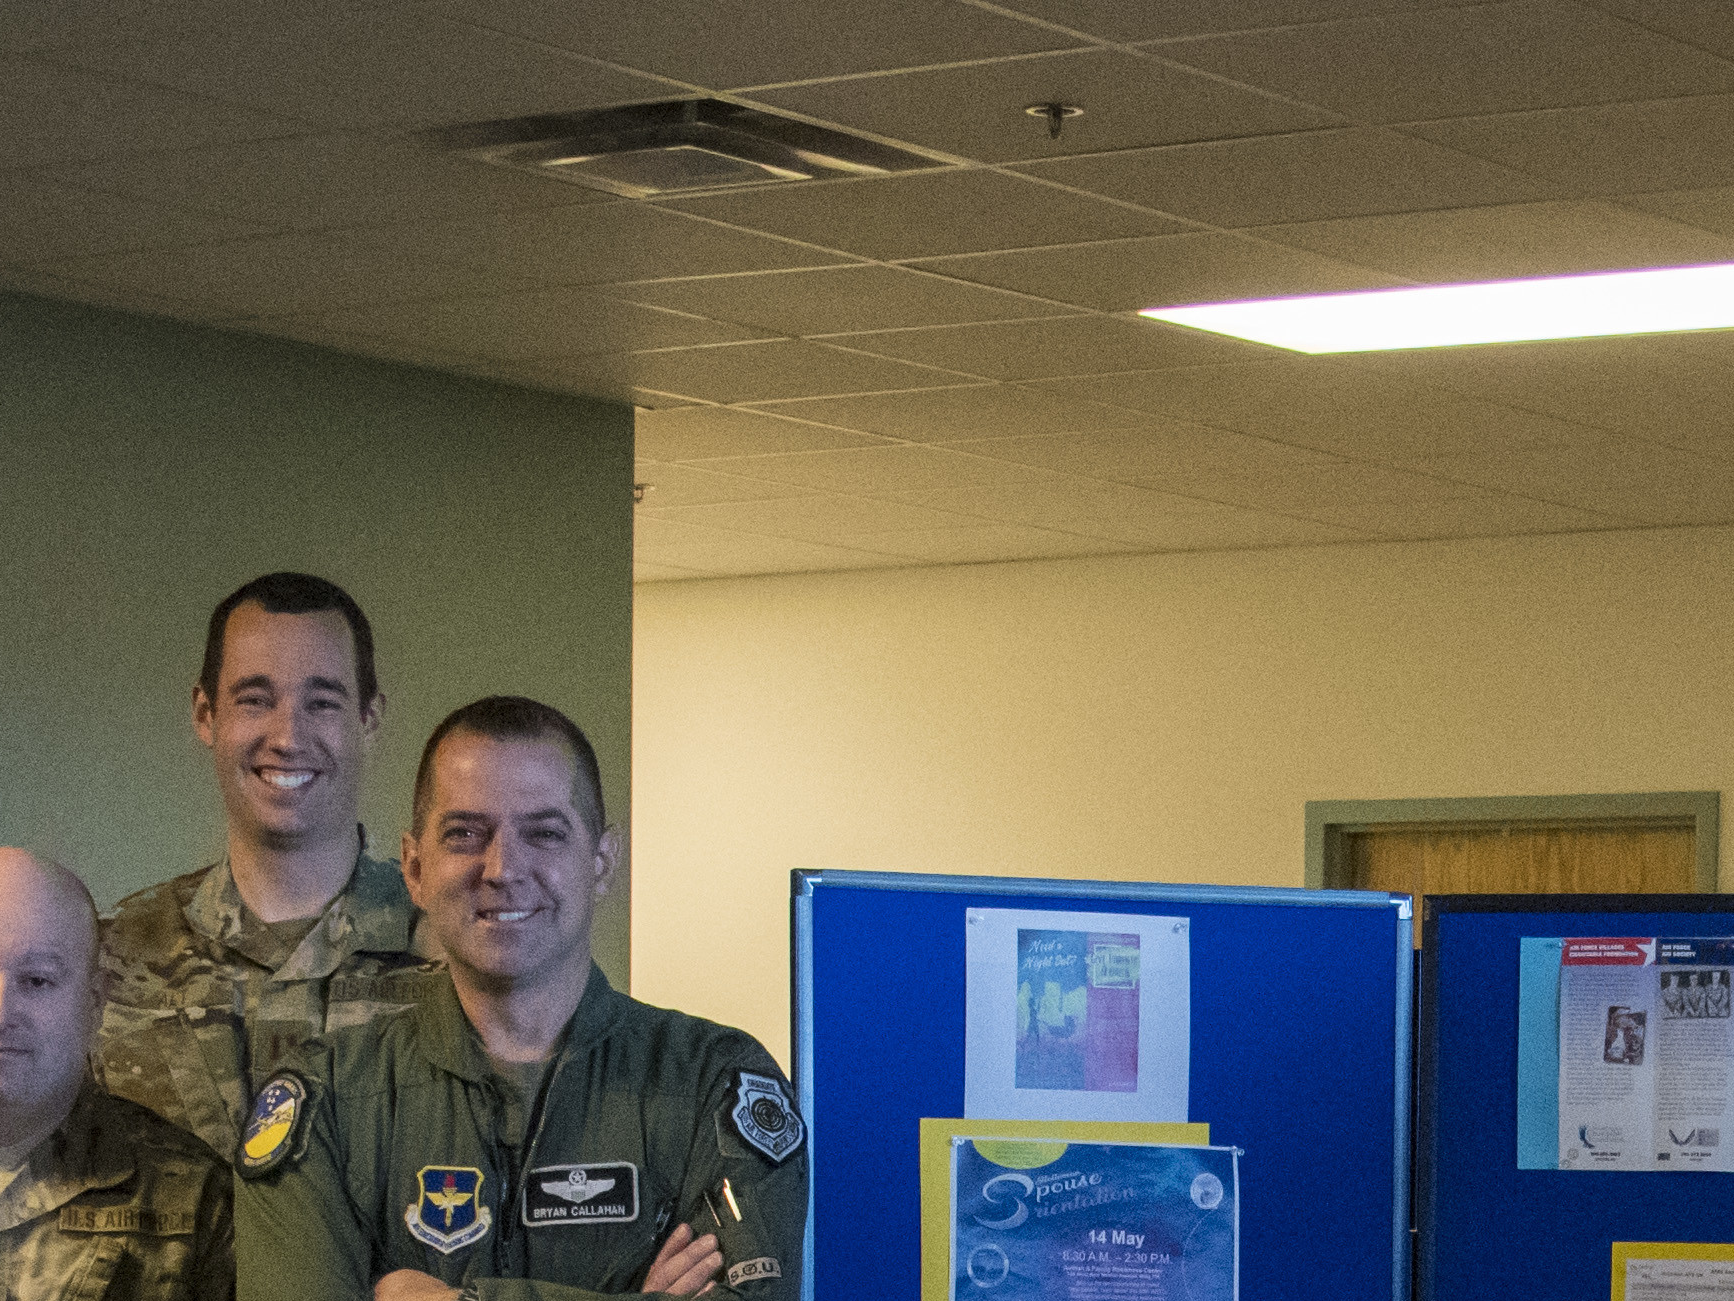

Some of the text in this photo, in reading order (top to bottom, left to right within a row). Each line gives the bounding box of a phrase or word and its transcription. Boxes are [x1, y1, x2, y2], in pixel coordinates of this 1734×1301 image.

[532, 1204, 626, 1219] BRYAN CALLAHAN
[1088, 1229, 1145, 1248] 14 May
